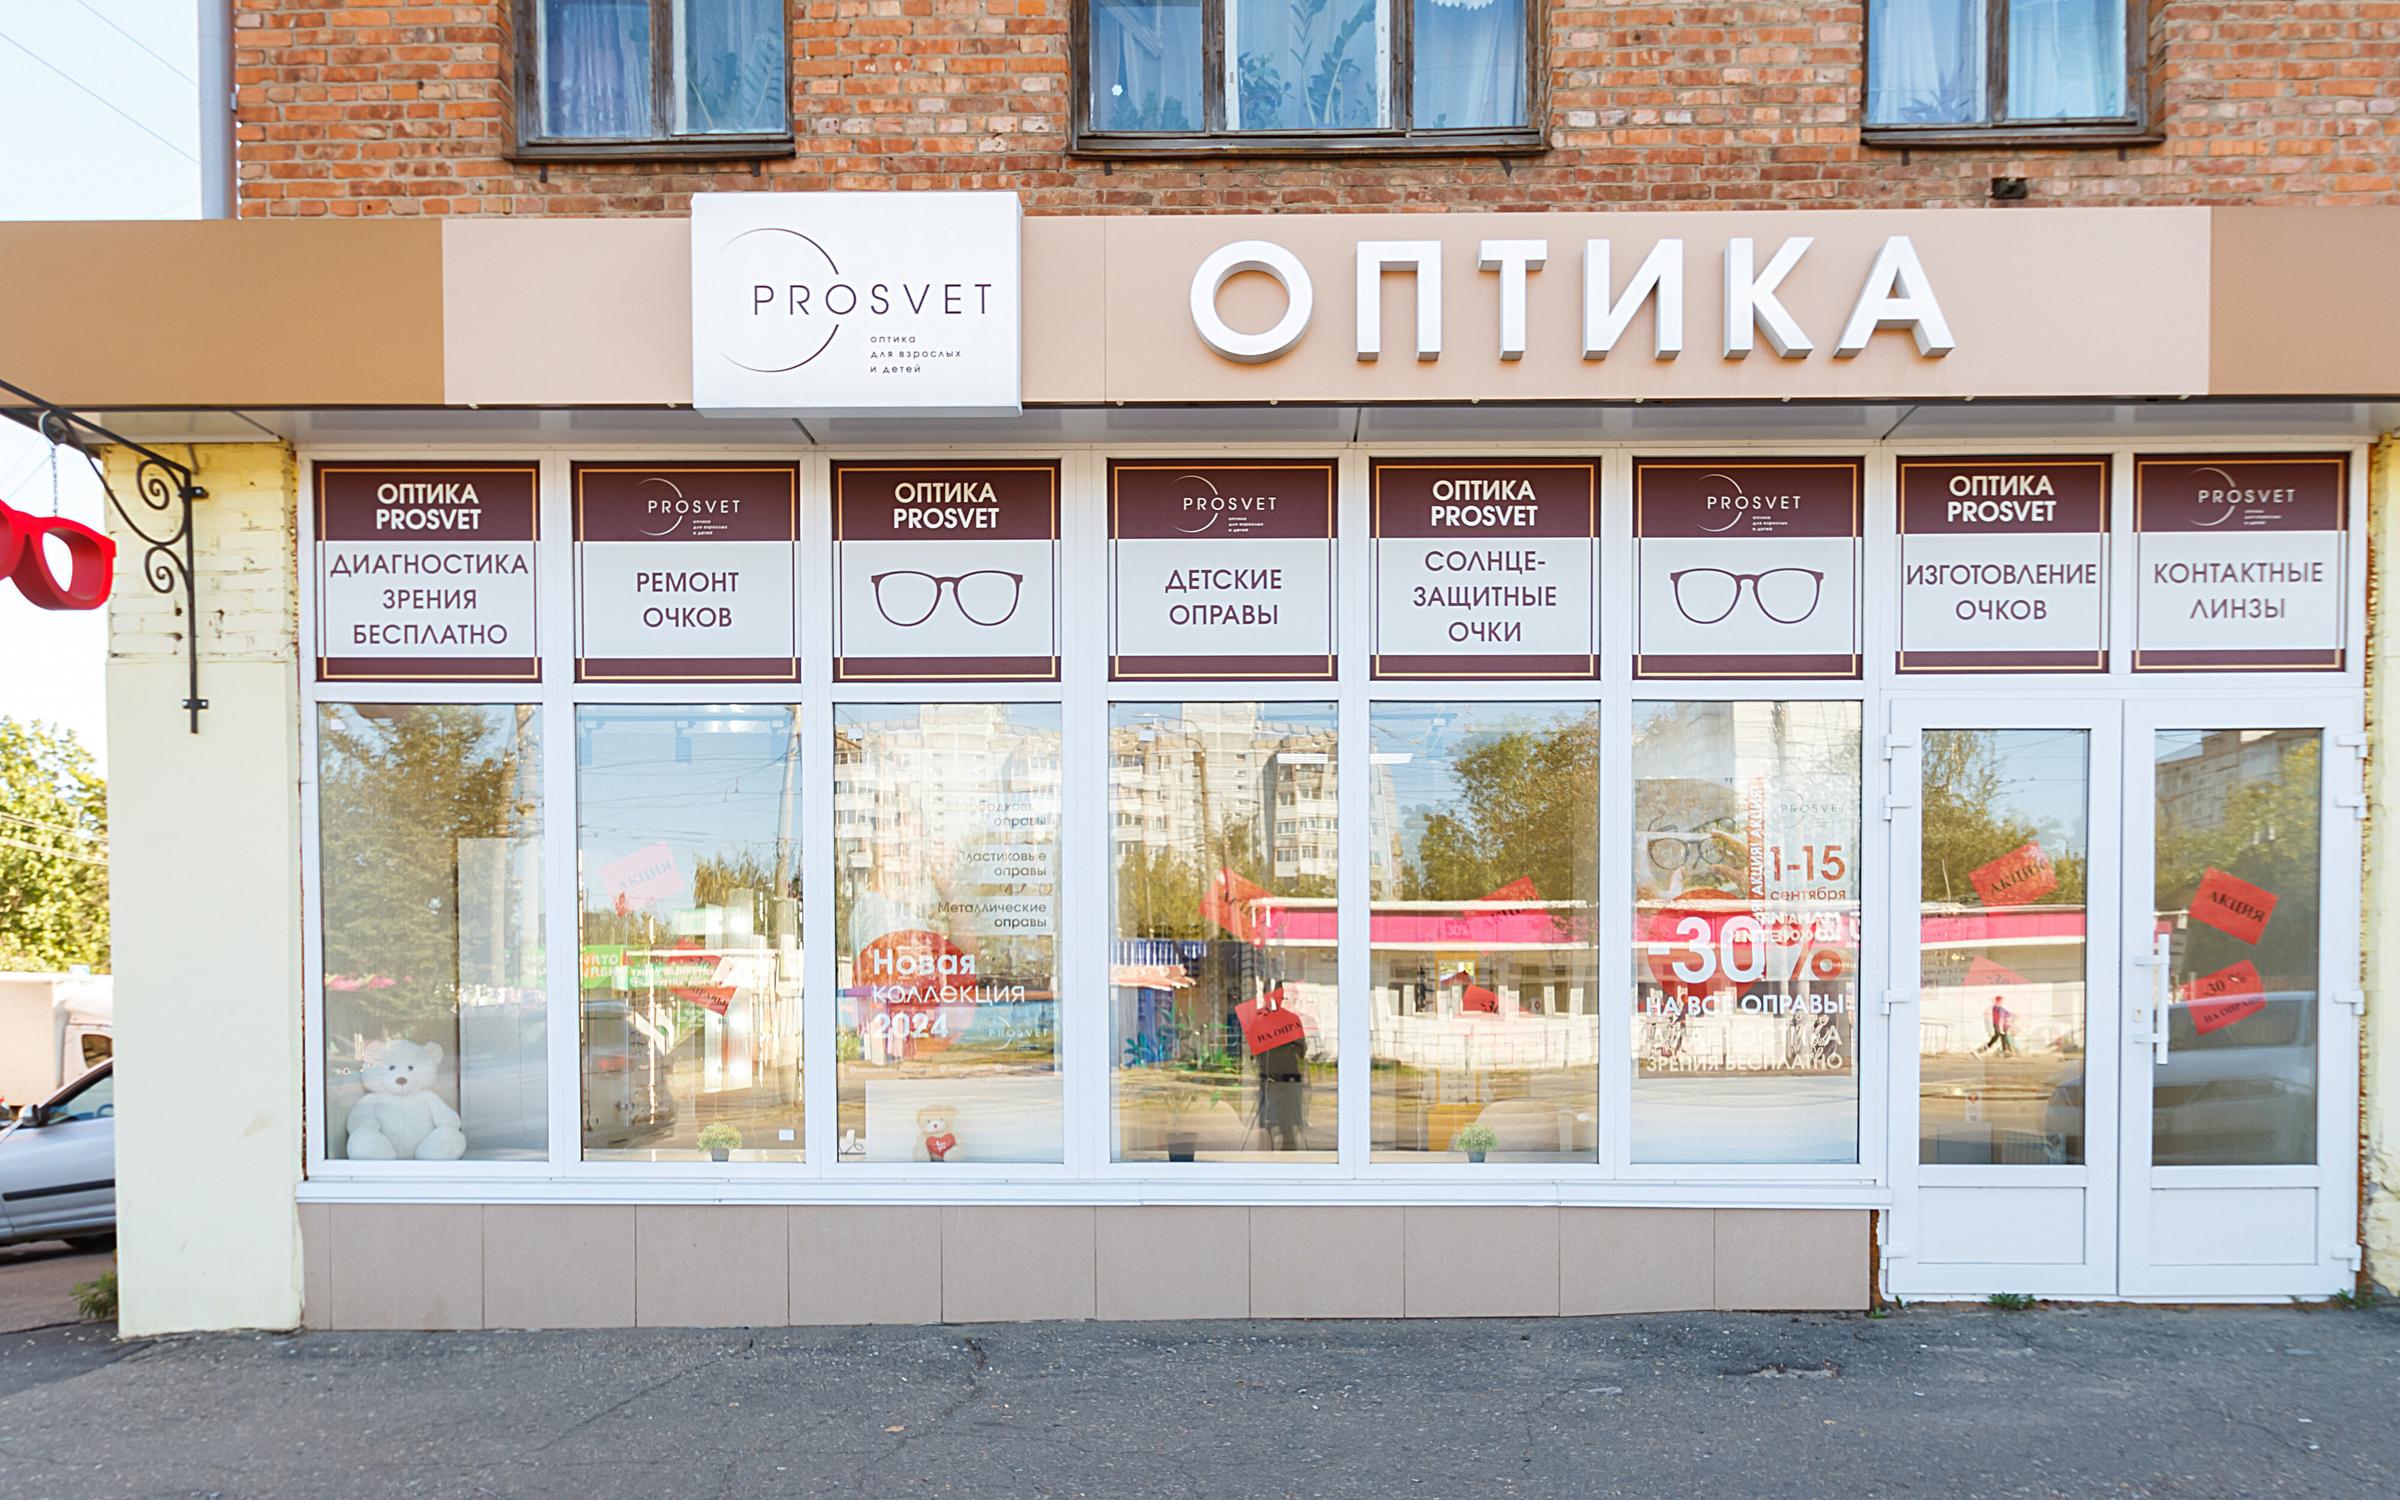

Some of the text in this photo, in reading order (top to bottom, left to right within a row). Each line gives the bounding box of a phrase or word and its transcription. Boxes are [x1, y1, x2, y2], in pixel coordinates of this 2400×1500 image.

[754, 283, 992, 316] PROSVET
[1189, 235, 1956, 363] ОПТИКА
[870, 336, 916, 344] оптика
[870, 350, 961, 360] для взрослых
[882, 364, 921, 374] детей
[377, 483, 480, 505] ОПТИКА
[894, 482, 998, 504] ОПТИКА
[1432, 479, 1536, 501] ОПТИКА
[1949, 475, 2055, 497] ОПТИКА
[2198, 488, 2296, 504] PROSVET
[648, 499, 740, 514] PROSVET
[1183, 497, 1277, 511] PROSVET
[1707, 495, 1801, 510] PROSVET
[1947, 500, 2057, 523] PROSVET
[376, 508, 482, 530] PROSVET
[893, 507, 1000, 529] PROSVET
[1431, 505, 1539, 527] PROSVET
[330, 553, 529, 578] ДИАГНОСТИКА
[1424, 550, 1546, 575] СОЛНЦЕ-
[2154, 561, 2323, 584] КОНТАКТНЫЕ
[636, 571, 740, 593] РЕМОНТ
[1164, 568, 1282, 594] ДЕТСКИЕ
[1906, 563, 2097, 586] ИЗГОТОВЛЕНИЕ
[382, 588, 477, 610] ЗРЕНИЯ
[1413, 586, 1557, 611] ЗАЩИТНЫЕ
[2189, 597, 2285, 620] ЛИНЗЫ
[643, 607, 732, 628] ОЧКОВ
[1169, 604, 1278, 626] ОПРАВЫ
[1955, 599, 2047, 621] ОЧКОВ
[353, 624, 508, 645] БЕСПЛАТНО
[1448, 621, 1521, 643] ОЧКИ
[994, 866, 1047, 878] оправы
[1770, 845, 1846, 881] 1-15
[1770, 886, 1847, 901] сентября
[937, 901, 1047, 913] Металлические
[2210, 890, 2266, 923] АКЦИЯ
[994, 917, 1047, 929] оправы
[873, 948, 976, 976] Новая
[872, 984, 1025, 1006] коллекция
[1741, 993, 1844, 1015] ОПРАВЫ
[873, 1012, 950, 1038] 2024
